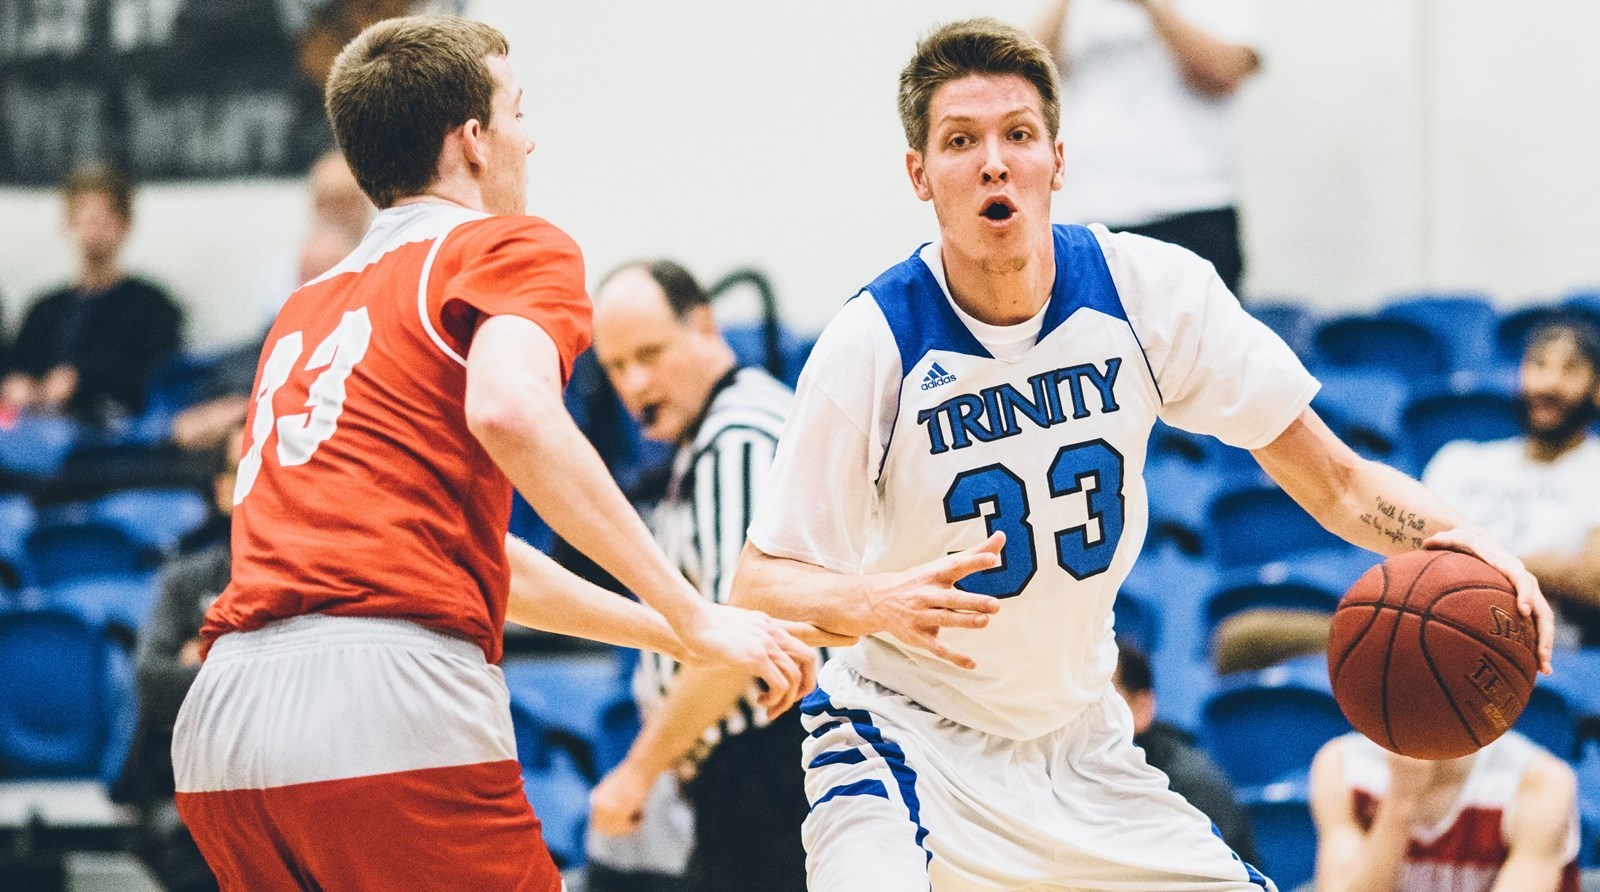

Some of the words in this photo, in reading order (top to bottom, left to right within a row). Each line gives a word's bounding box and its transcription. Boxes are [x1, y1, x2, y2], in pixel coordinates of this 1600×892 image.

[232, 305, 373, 507] 33
[916, 356, 1123, 455] TRINITY
[920, 374, 957, 391] adidas
[942, 437, 1126, 600] 33
